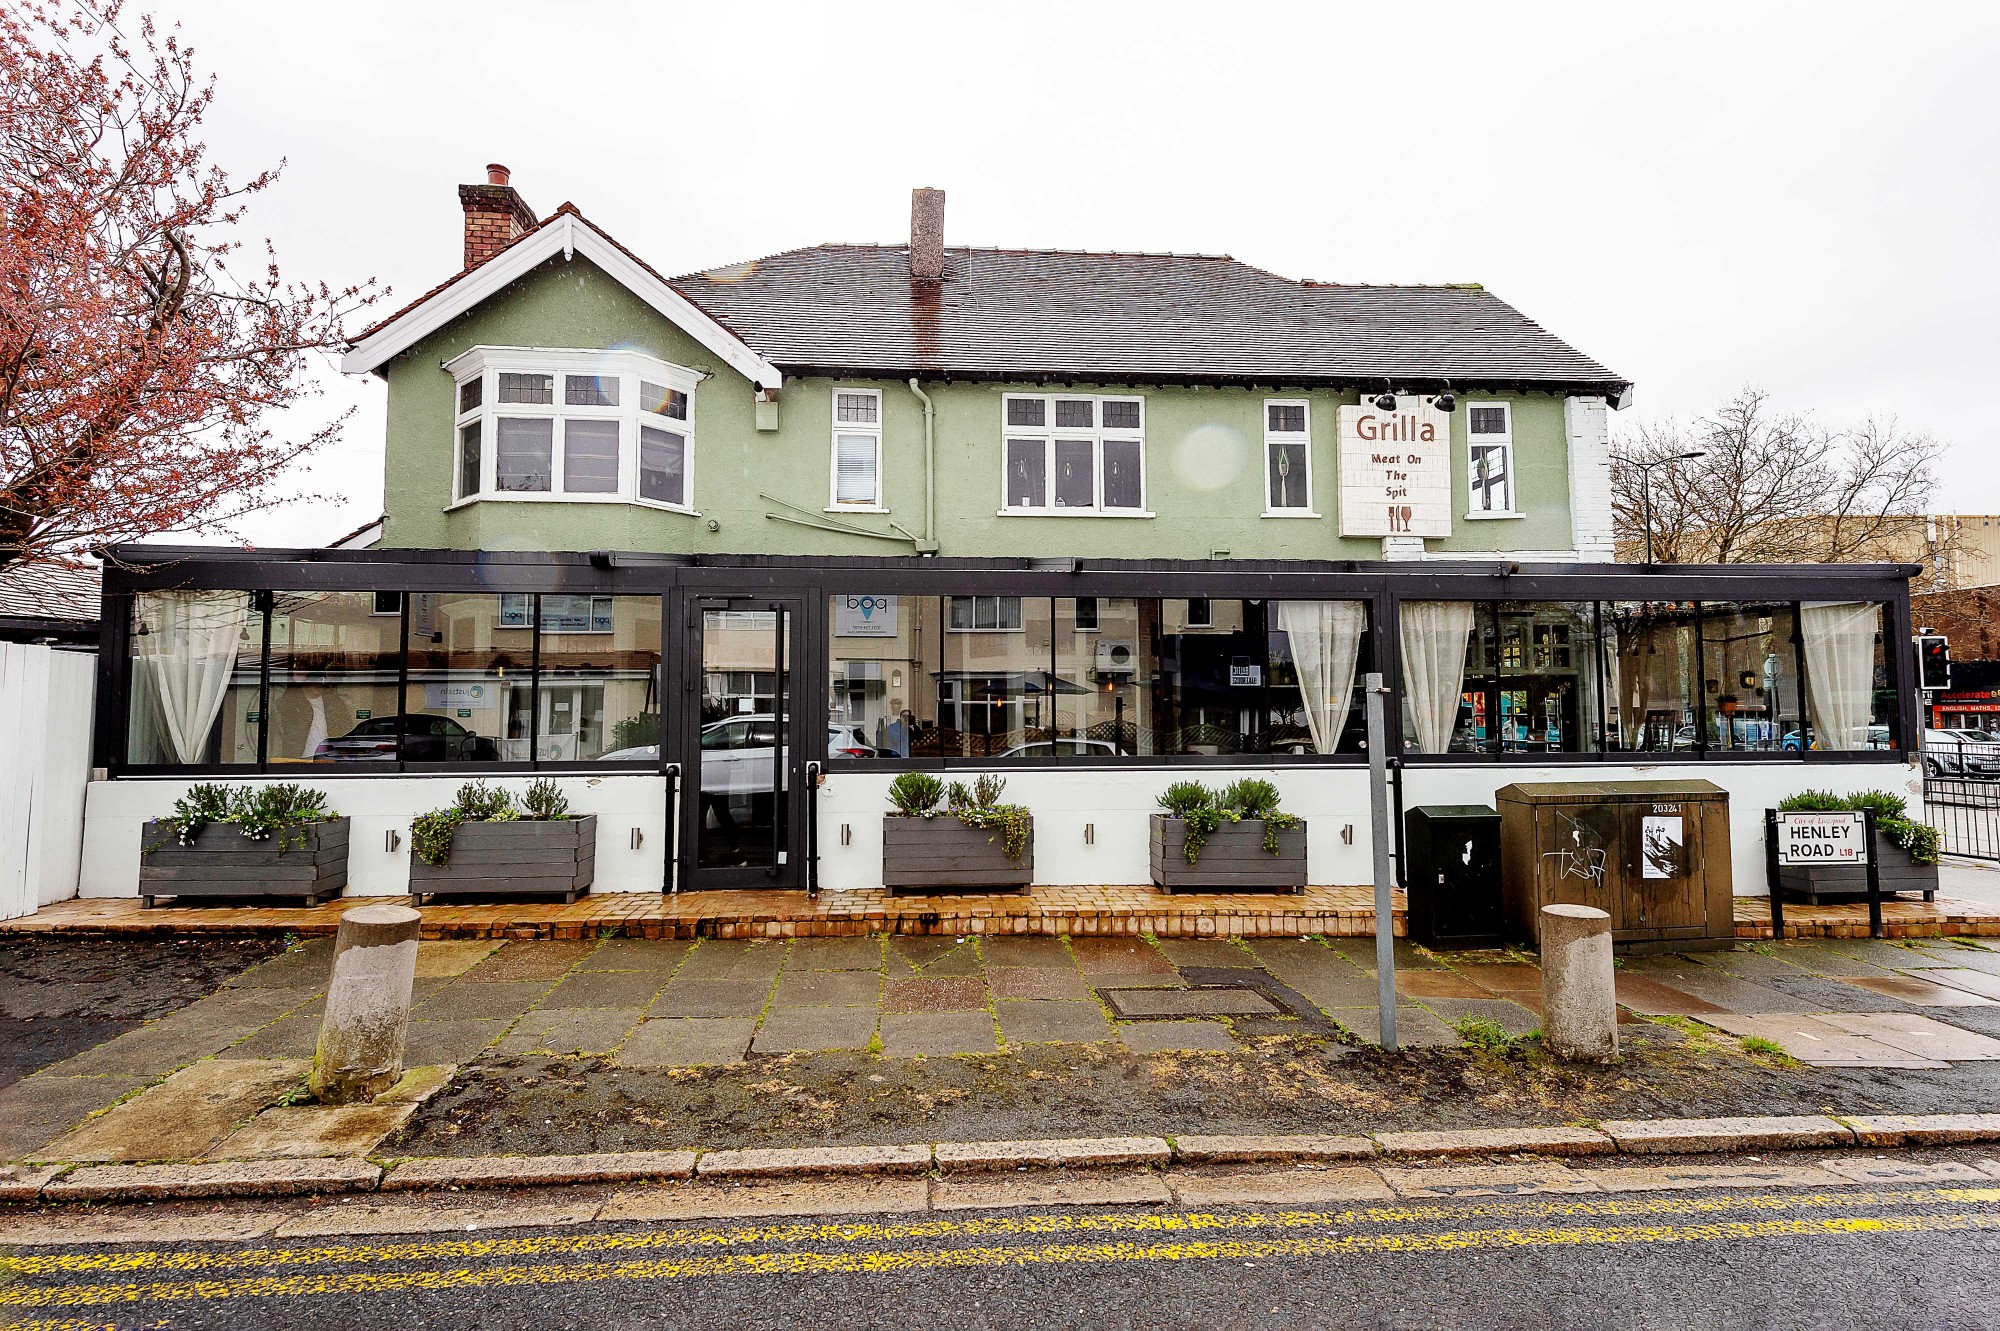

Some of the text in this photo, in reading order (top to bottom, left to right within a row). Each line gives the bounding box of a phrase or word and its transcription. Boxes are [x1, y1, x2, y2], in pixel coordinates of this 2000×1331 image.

[1356, 413, 1435, 442] Grilla
[1371, 453, 1422, 465] Meat On
[1385, 470, 1407, 481] The
[1385, 485, 1407, 499] Spit
[1941, 690, 1991, 699] Accelerate
[1652, 804, 1682, 813] 203241
[1794, 817, 1806, 825] City
[1808, 817, 1815, 825] of
[1790, 826, 1850, 839] HENLEY
[1790, 844, 1853, 857] ROAD L18
